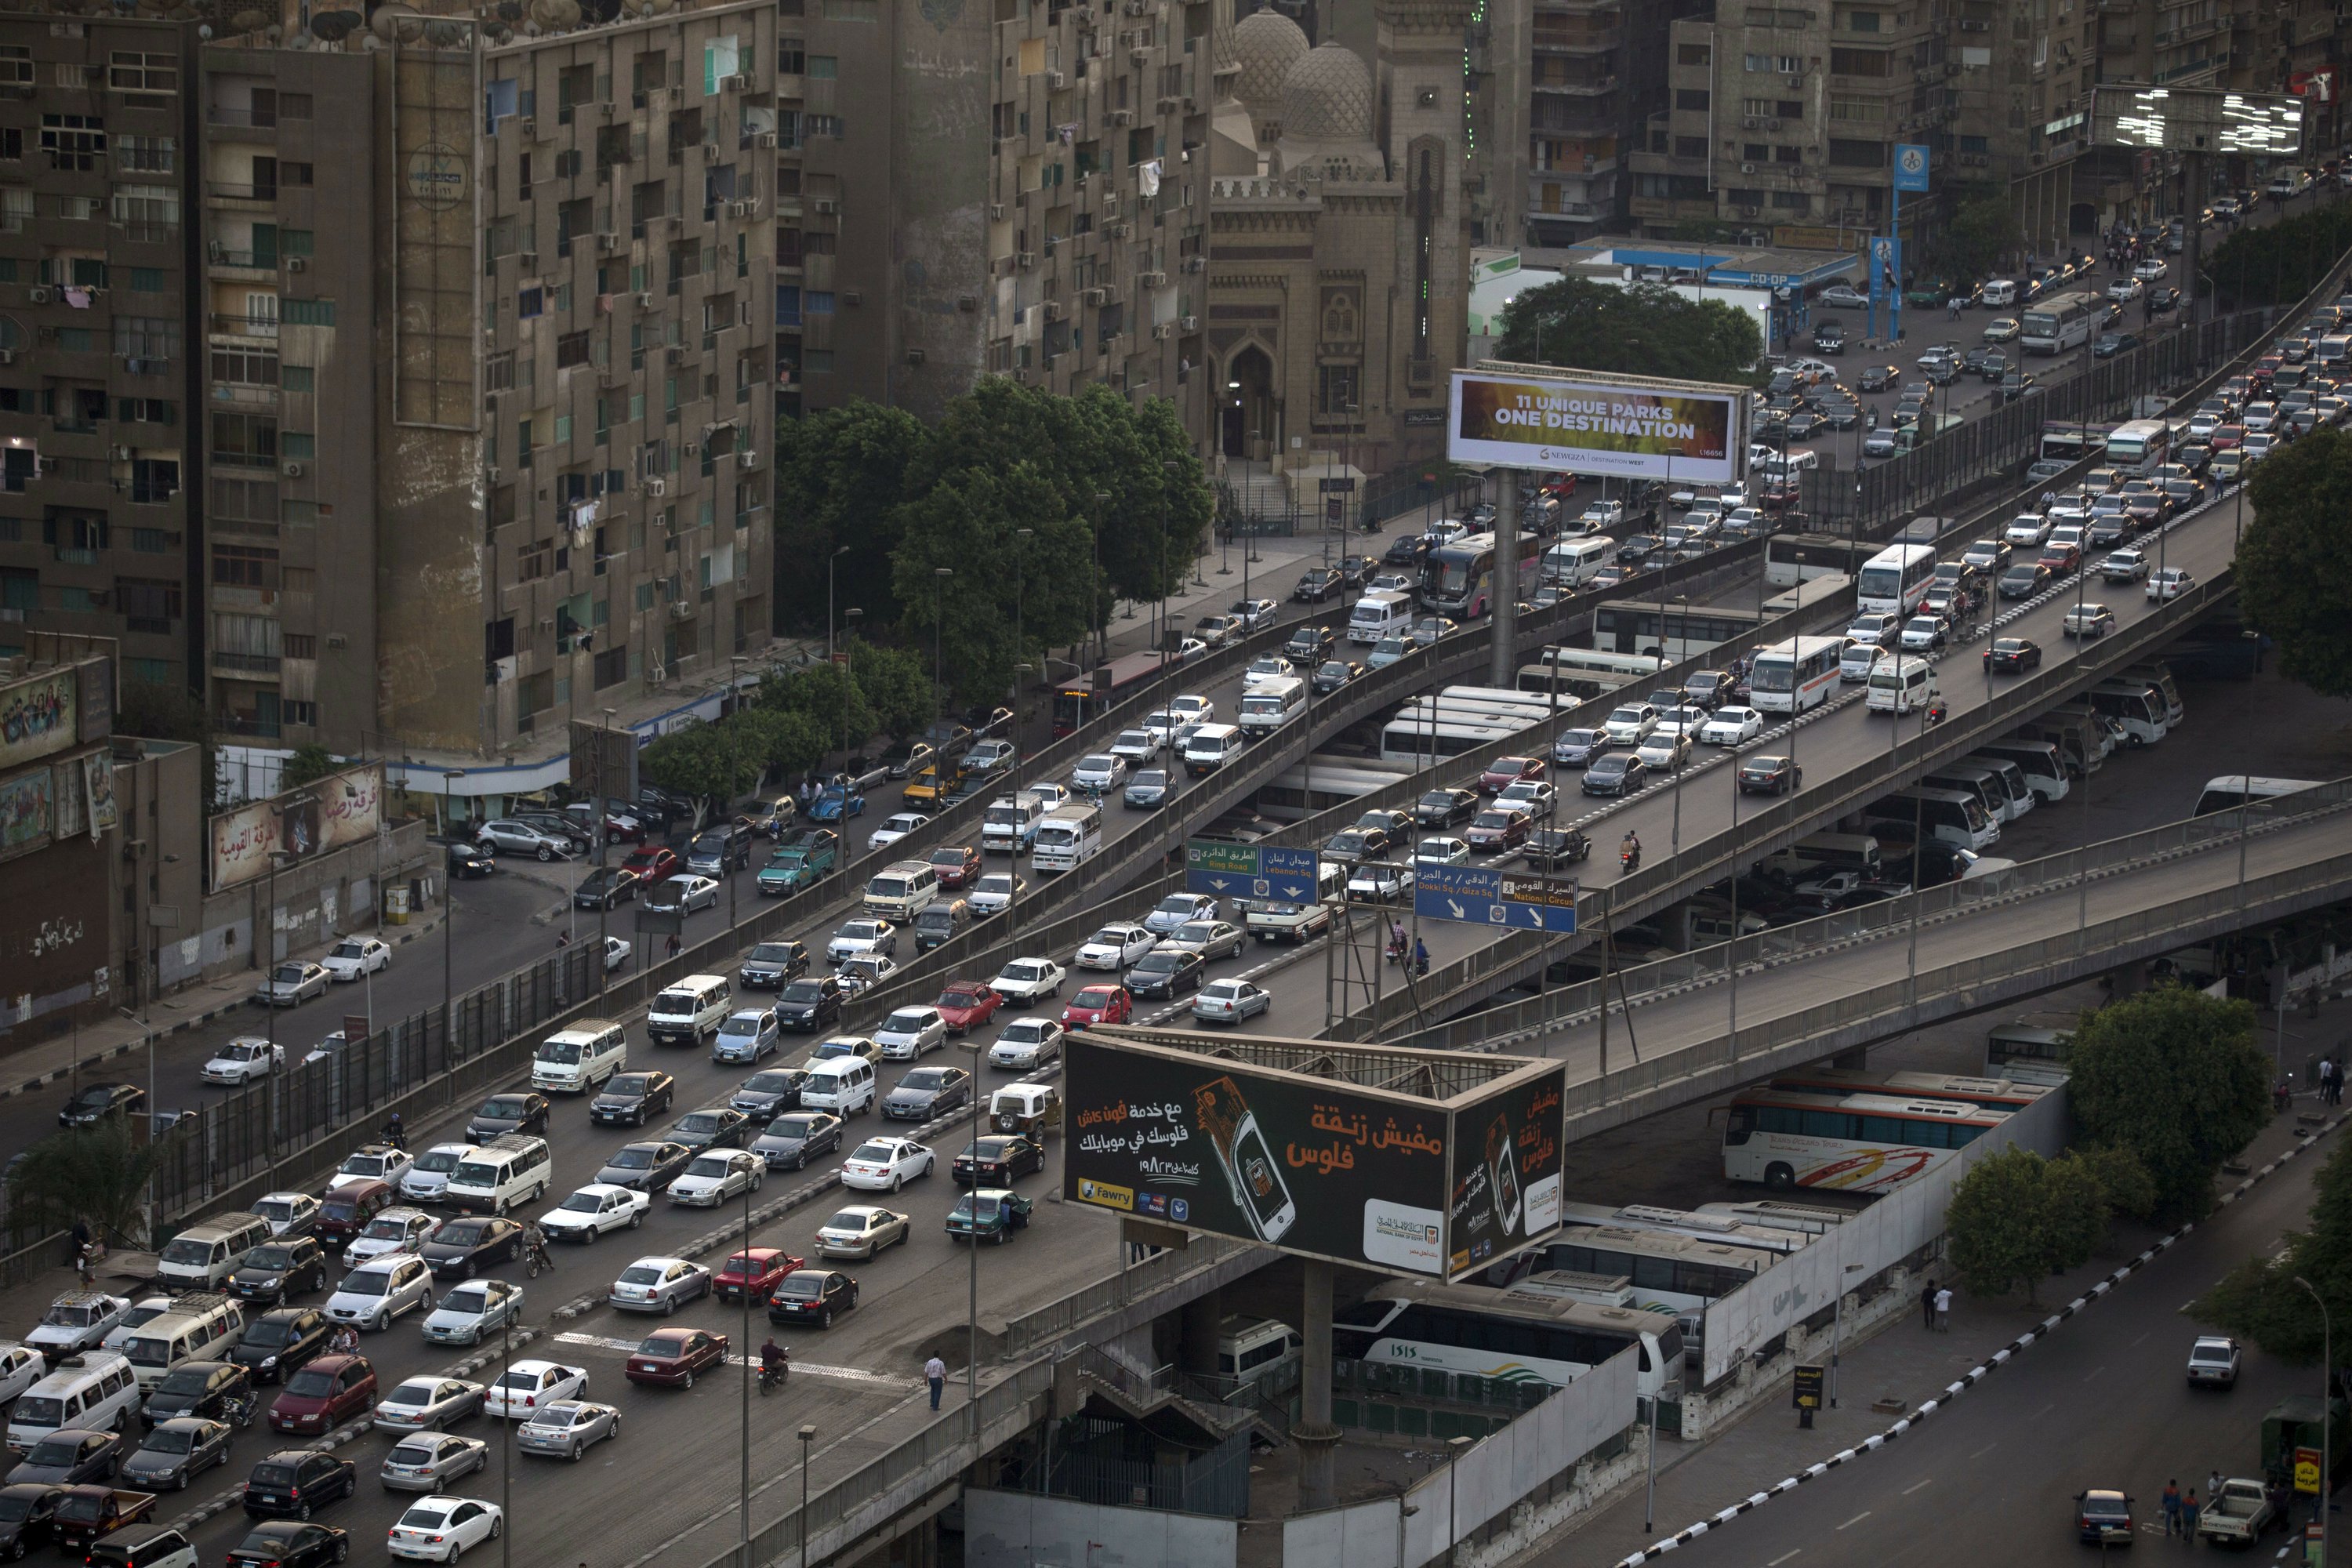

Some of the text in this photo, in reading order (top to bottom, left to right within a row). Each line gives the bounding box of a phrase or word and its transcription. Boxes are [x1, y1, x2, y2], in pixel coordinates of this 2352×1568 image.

[1516, 394, 1673, 421] 11 UNIQUE PARKS
[1495, 408, 1695, 440] ONE DESTINATION
[1551, 452, 1585, 462] NEWGIZA
[1591, 456, 1628, 465] DESTINATION
[354, 786, 376, 813] فرقة
[220, 827, 251, 862] القومية
[1229, 849, 1255, 861] الطريق
[1268, 852, 1310, 867] ميدان لبنان
[1209, 860, 1248, 871] Ring Road
[1265, 866, 1298, 876] Lebanon
[1416, 869, 1441, 881] الجيزة
[1418, 881, 1441, 891] Dokki
[1462, 887, 1480, 896] Giza
[1546, 883, 1573, 895] السيرك
[1513, 891, 1573, 906] National Circus
[1527, 1086, 1559, 1120] مفيش
[1077, 1099, 1181, 1127] مع خدمة فون كاش
[1311, 1104, 1442, 1155] مفيش زنقة
[1518, 1122, 1541, 1148] زنقة
[1079, 1124, 1189, 1154] فلوسك في موبايلك
[1822, 1140, 1844, 1149] TOURS
[1287, 1141, 1355, 1174] فلوس
[1522, 1138, 1554, 1174] فلوس
[1097, 1186, 1130, 1204] fawry
[1149, 1204, 1164, 1213] Mobile
[1392, 1343, 1417, 1359] ISIS
[2208, 1523, 2241, 1531] CHEVROLET
